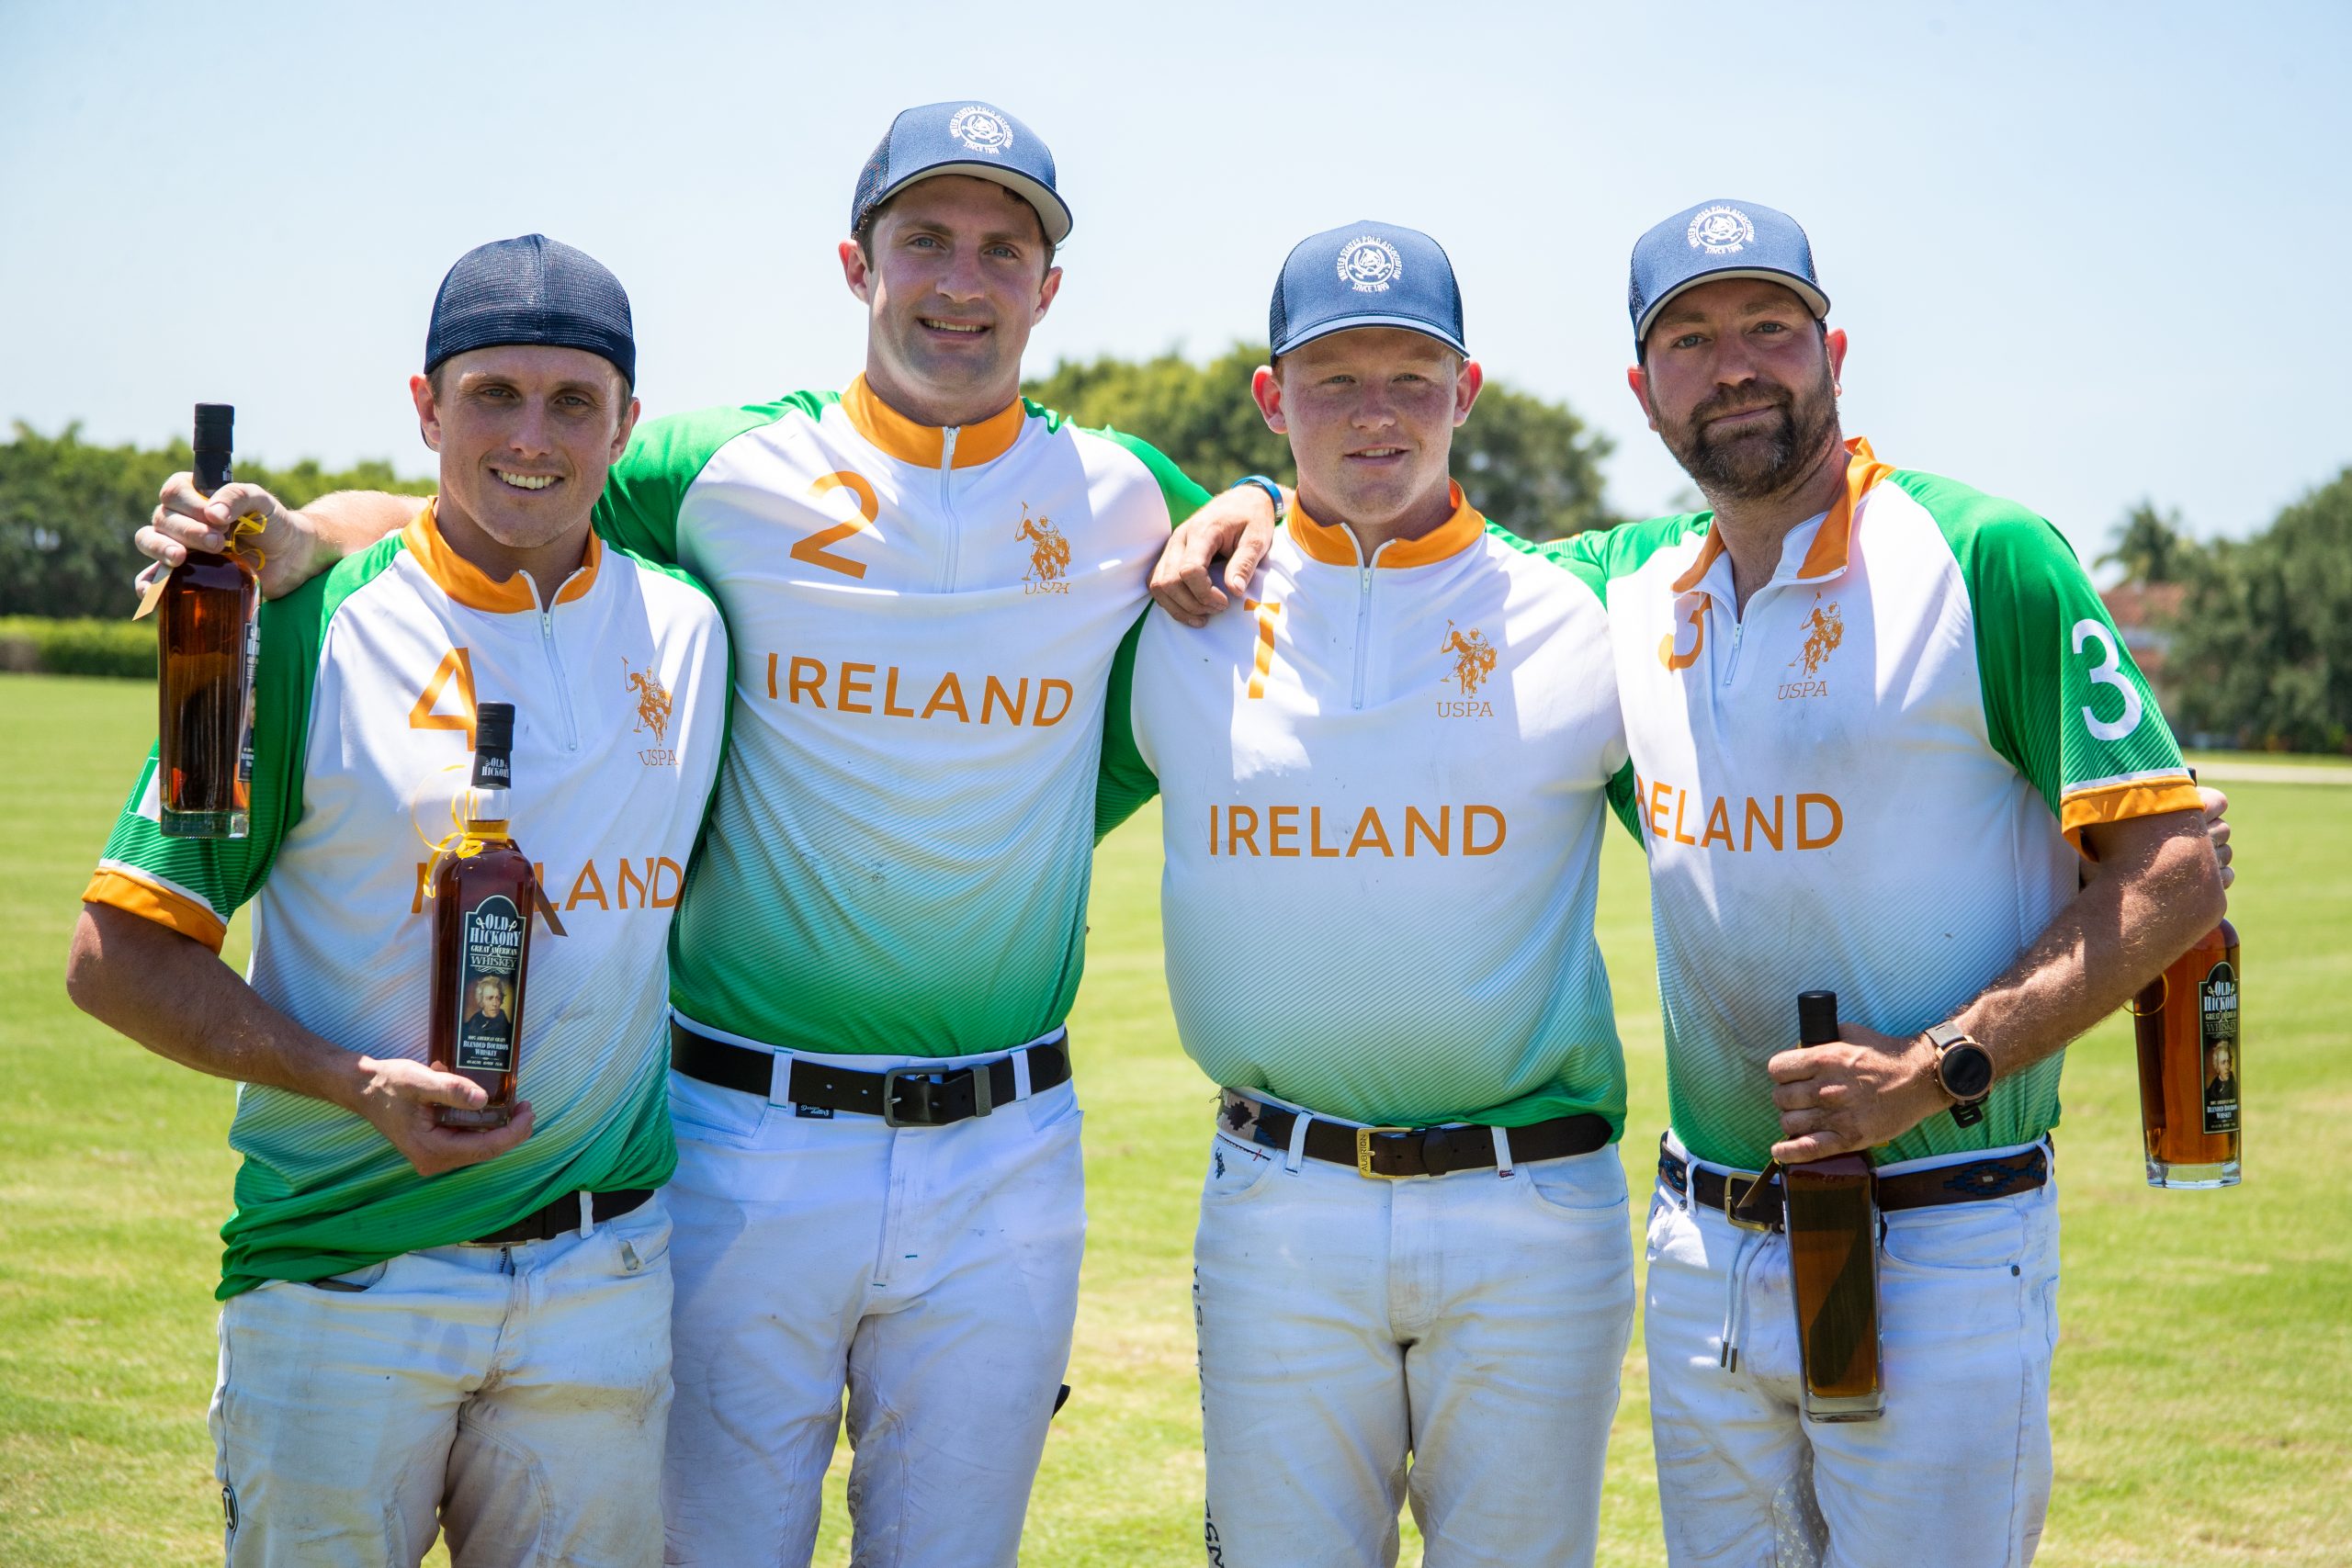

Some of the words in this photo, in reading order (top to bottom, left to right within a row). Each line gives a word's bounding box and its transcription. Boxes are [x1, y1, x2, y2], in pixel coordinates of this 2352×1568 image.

[1363, 235, 1381, 243] POLO
[1352, 283, 1373, 292] SINCE
[790, 470, 878, 580] 2
[1023, 581, 1070, 595] USPA
[2072, 618, 2143, 741] 3
[767, 652, 1073, 727] IRELAND
[1778, 681, 1828, 700] USPA
[409, 647, 478, 751] 4
[1436, 701, 1494, 718] USPA
[491, 757, 504, 768] OLD
[637, 750, 678, 765] USPA
[1635, 773, 1844, 853] RELAND
[1209, 805, 1507, 857] IRELAND
[412, 856, 684, 913] ILAND
[485, 913, 509, 931] OLD
[469, 927, 522, 947] HICKORY
[470, 944, 491, 953] GREAT
[471, 955, 516, 968] WHISKEY
[2214, 980, 2231, 997] OLD
